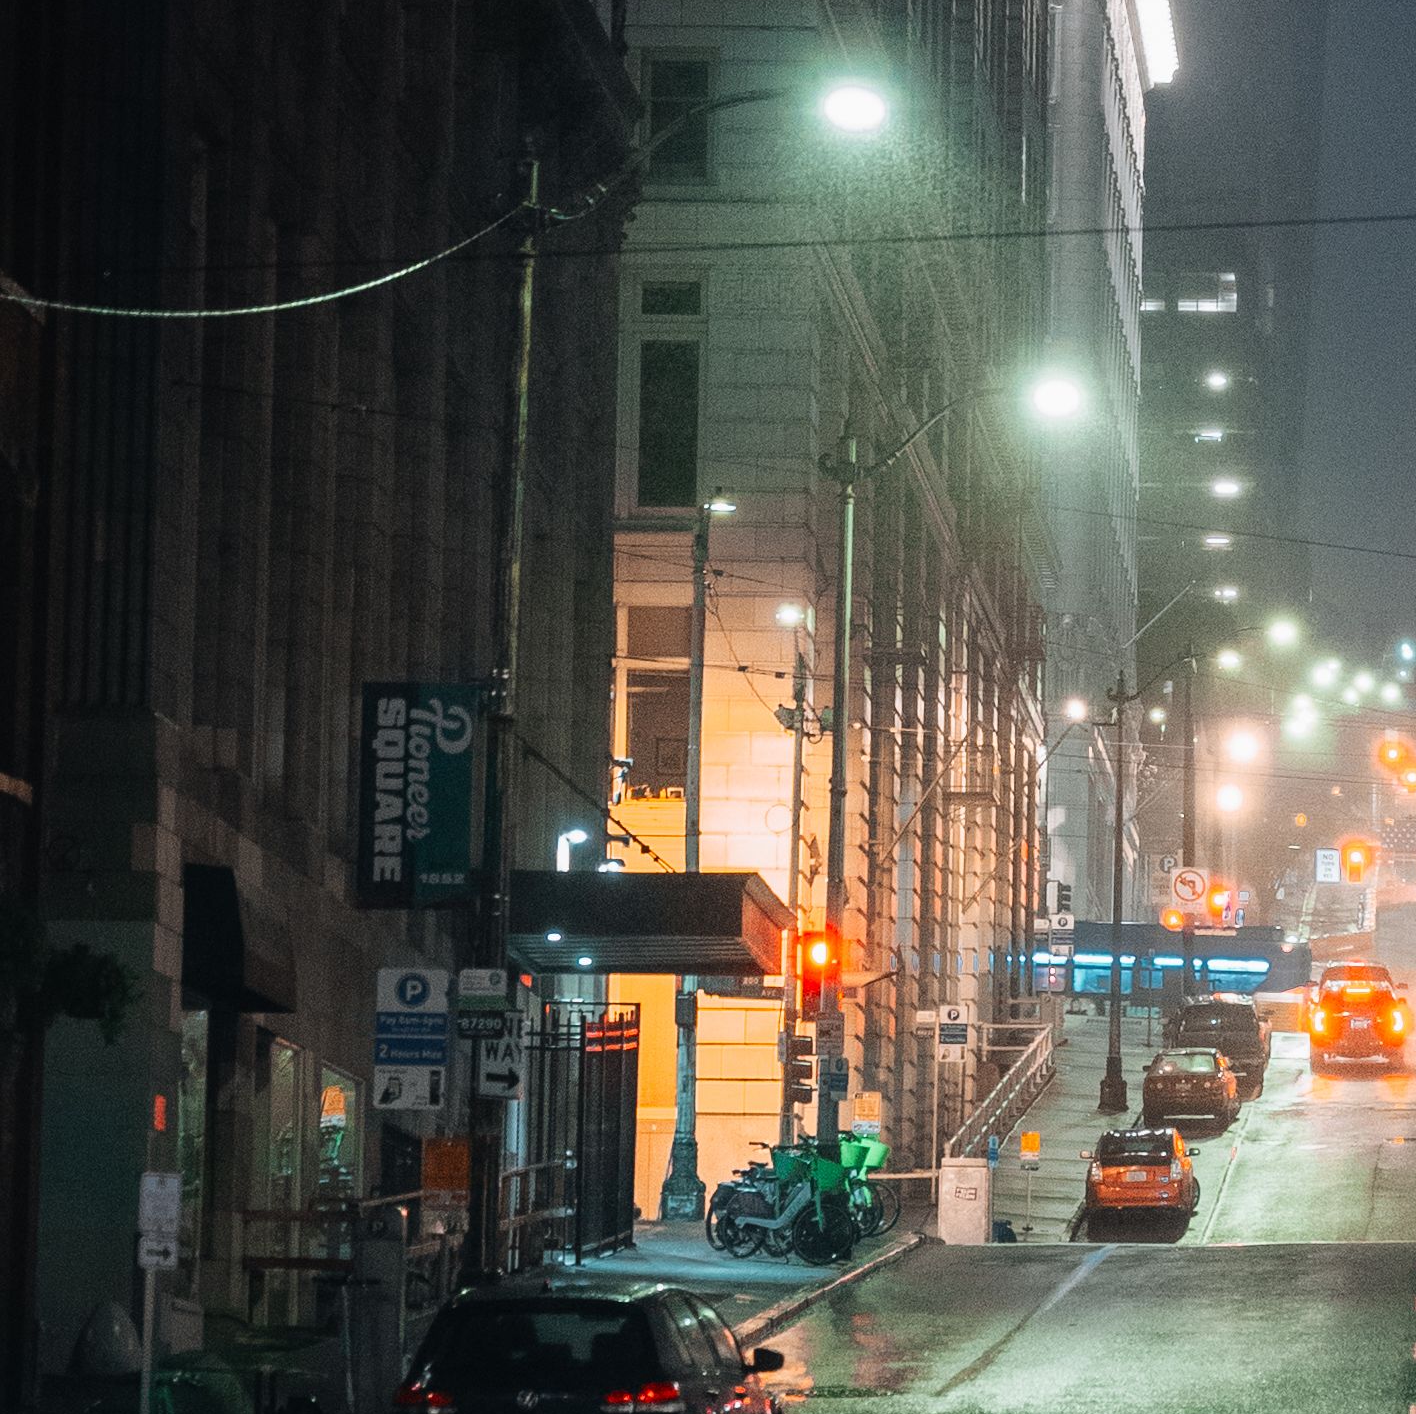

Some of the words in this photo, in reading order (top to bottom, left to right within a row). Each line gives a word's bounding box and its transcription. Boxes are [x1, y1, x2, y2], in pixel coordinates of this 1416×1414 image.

[372, 697, 407, 882] SQUARE
[406, 697, 472, 842] Pioneer
[379, 1044, 389, 1058] 2
[390, 1050, 420, 1059] Hours
